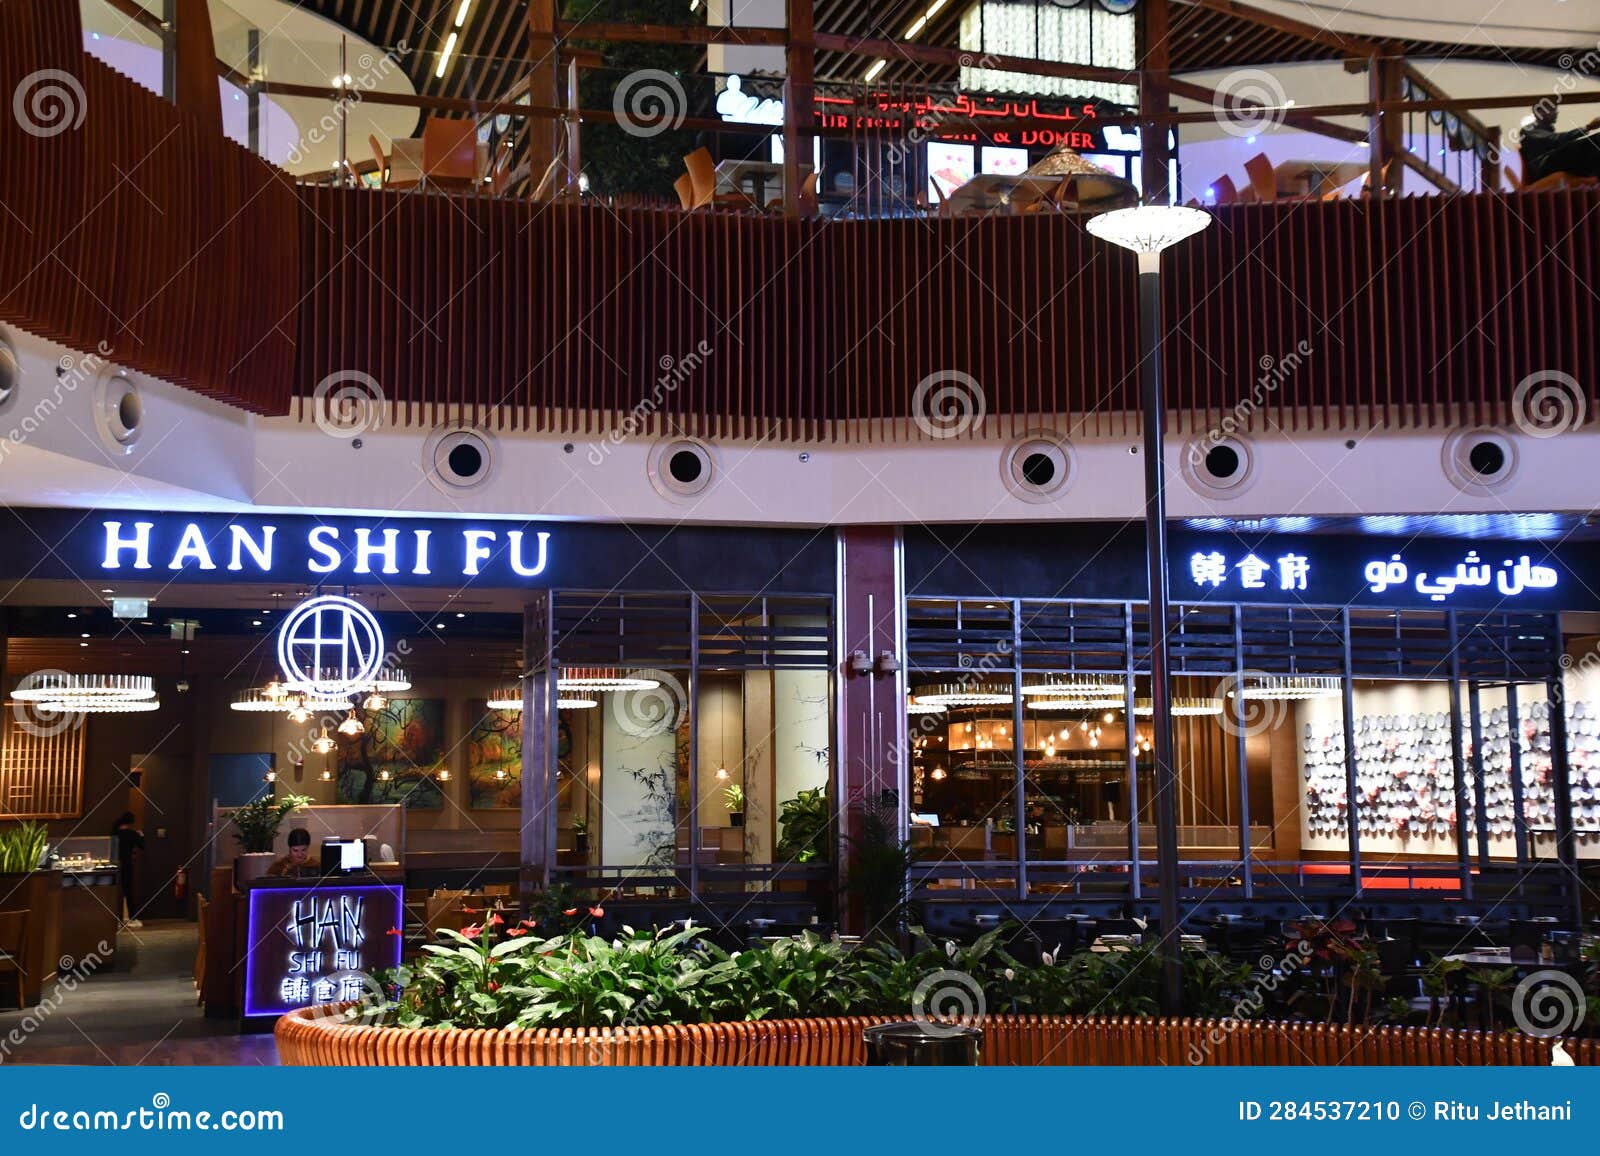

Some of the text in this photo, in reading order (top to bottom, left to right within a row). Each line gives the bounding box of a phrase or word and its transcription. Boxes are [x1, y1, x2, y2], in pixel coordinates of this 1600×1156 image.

[101, 521, 550, 576] HAN SHI FU
[1364, 550, 1558, 601] هان شي فو
[286, 895, 365, 949] HAN
[288, 951, 361, 973] SHI FU
